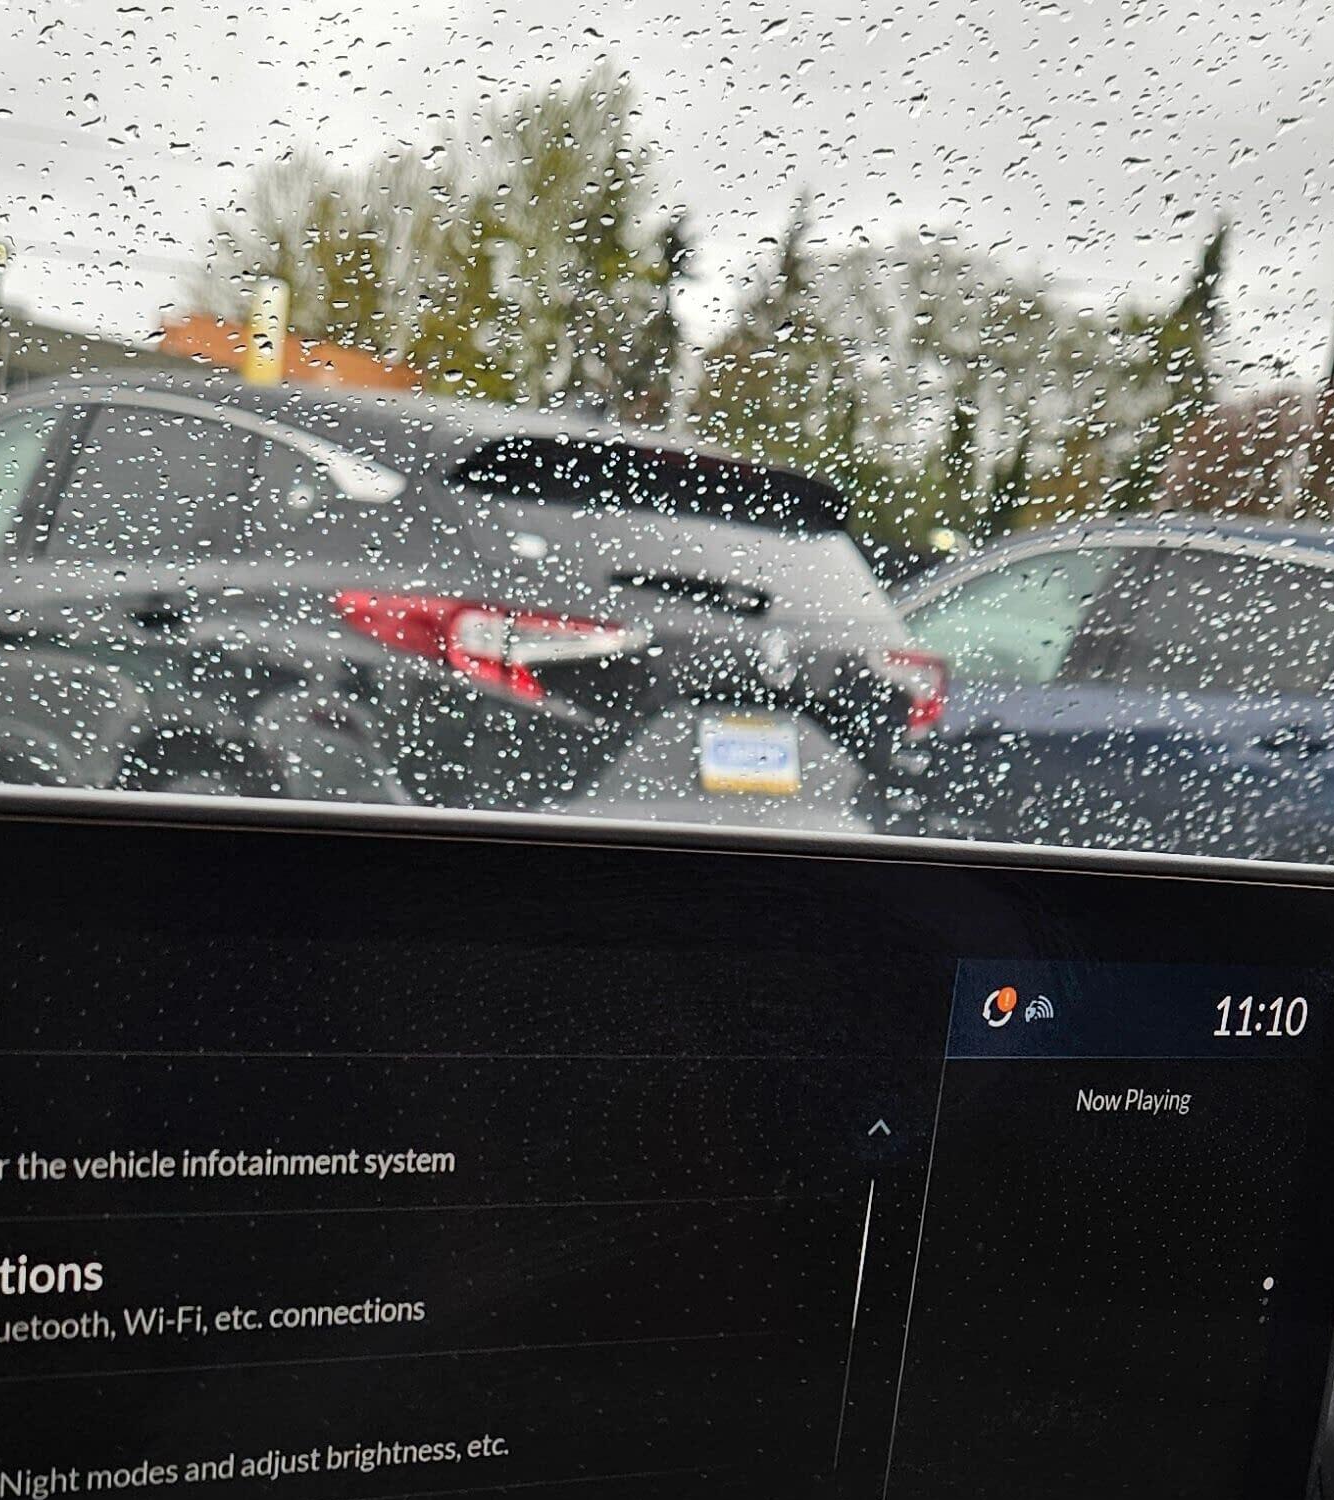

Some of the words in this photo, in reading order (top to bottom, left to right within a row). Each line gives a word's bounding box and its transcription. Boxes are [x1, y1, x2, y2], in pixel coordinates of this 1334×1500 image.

[1212, 994, 1309, 1038] 11:10
[1075, 1087, 1123, 1113] Now
[1124, 1087, 1193, 1117] Playing
[16, 1149, 68, 1181] the
[72, 1148, 177, 1181] vehicle
[181, 1147, 360, 1178] infotainment
[363, 1147, 457, 1181] system
[123, 1304, 209, 1337] Wi-Fi,
[214, 1304, 264, 1332] etc.
[269, 1296, 426, 1329] connections
[86, 1459, 180, 1492] modes
[183, 1452, 236, 1483] and
[239, 1447, 322, 1482] adjust
[325, 1438, 463, 1474] brightness,
[466, 1433, 510, 1459] etc.
